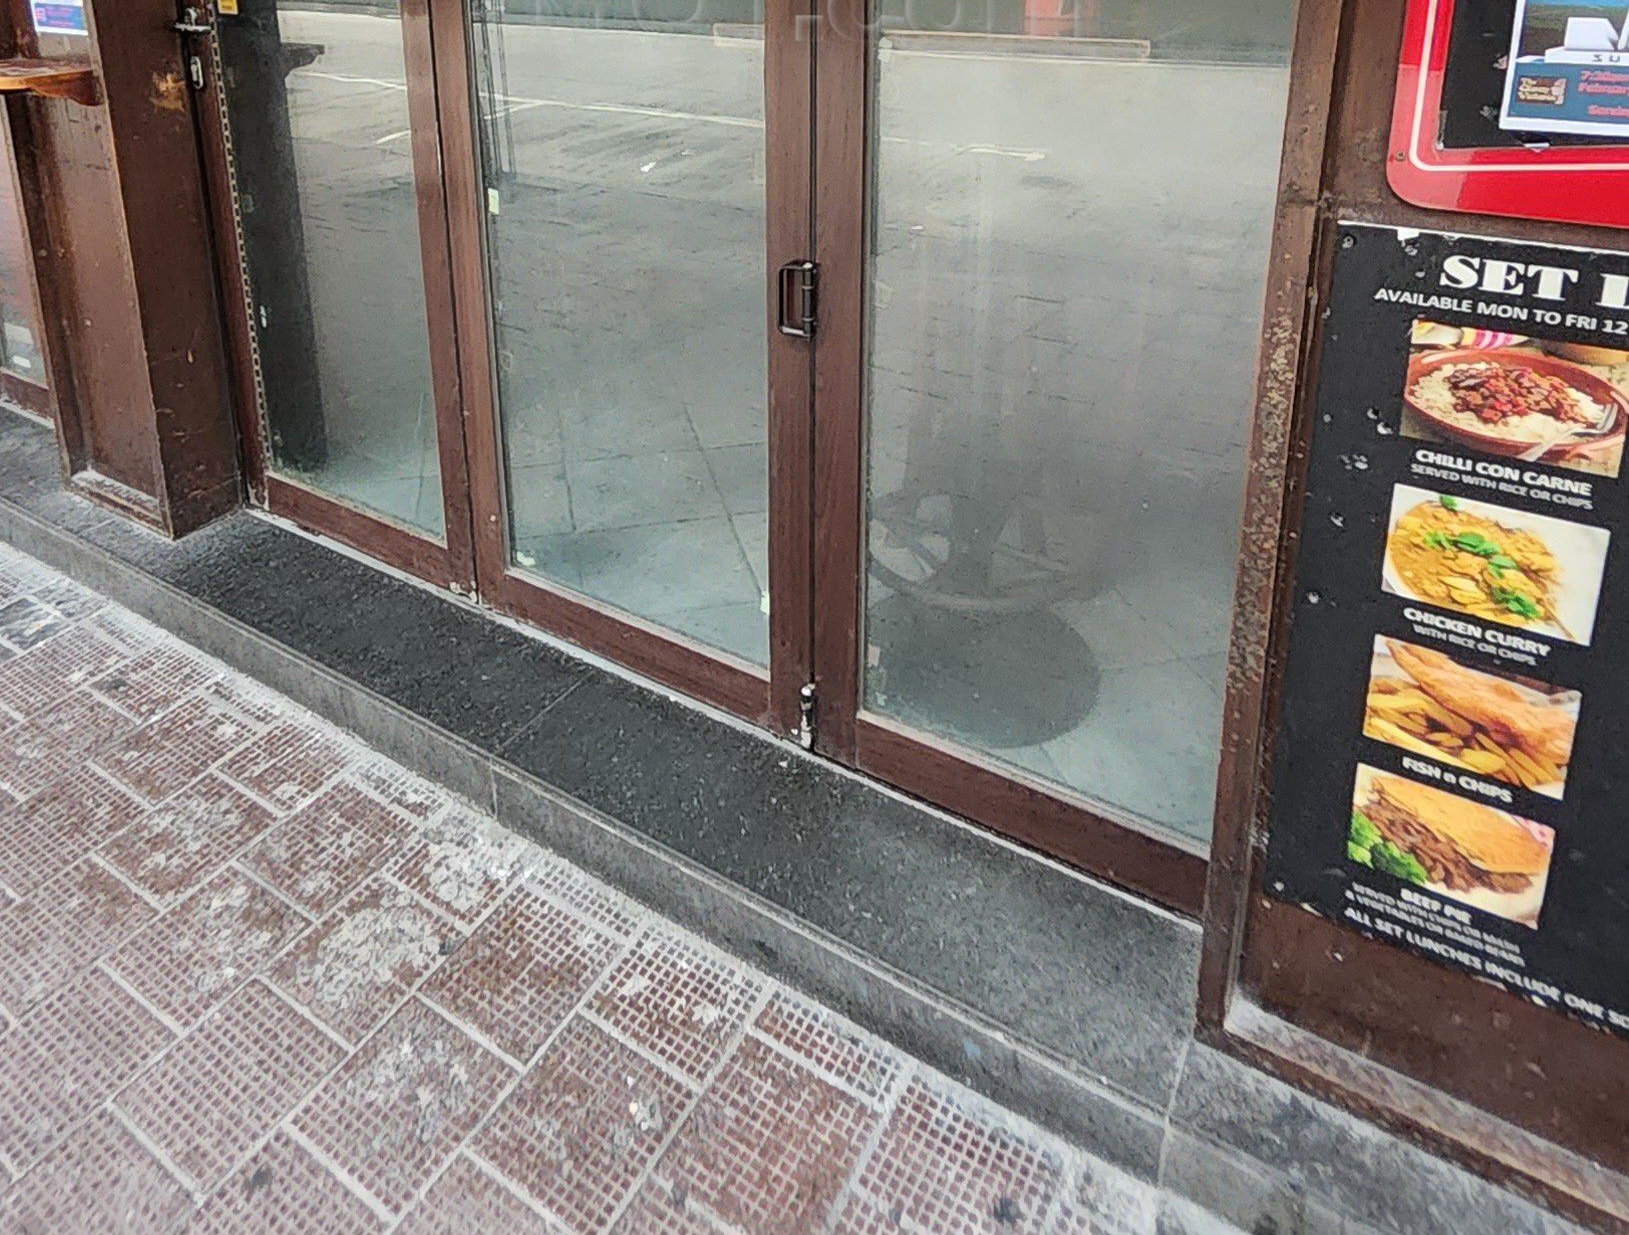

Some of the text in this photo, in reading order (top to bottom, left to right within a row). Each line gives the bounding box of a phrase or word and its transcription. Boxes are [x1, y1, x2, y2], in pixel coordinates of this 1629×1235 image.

[1439, 254, 1580, 302] SET
[1373, 287, 1473, 313] AVAILABLE
[1476, 301, 1530, 321] MON
[1532, 309, 1562, 326] TO
[1564, 314, 1598, 331] FRI
[1410, 463, 1594, 511] SERVED WITH RICE OR CHIPS
[1415, 449, 1593, 497] CHILLI CON CARNE
[1403, 606, 1551, 657] CHICKEN CURRY
[1412, 622, 1447, 641] WITH
[1477, 642, 1498, 656] OR
[1402, 755, 1442, 780] FISH
[1458, 775, 1514, 804] CHIPS
